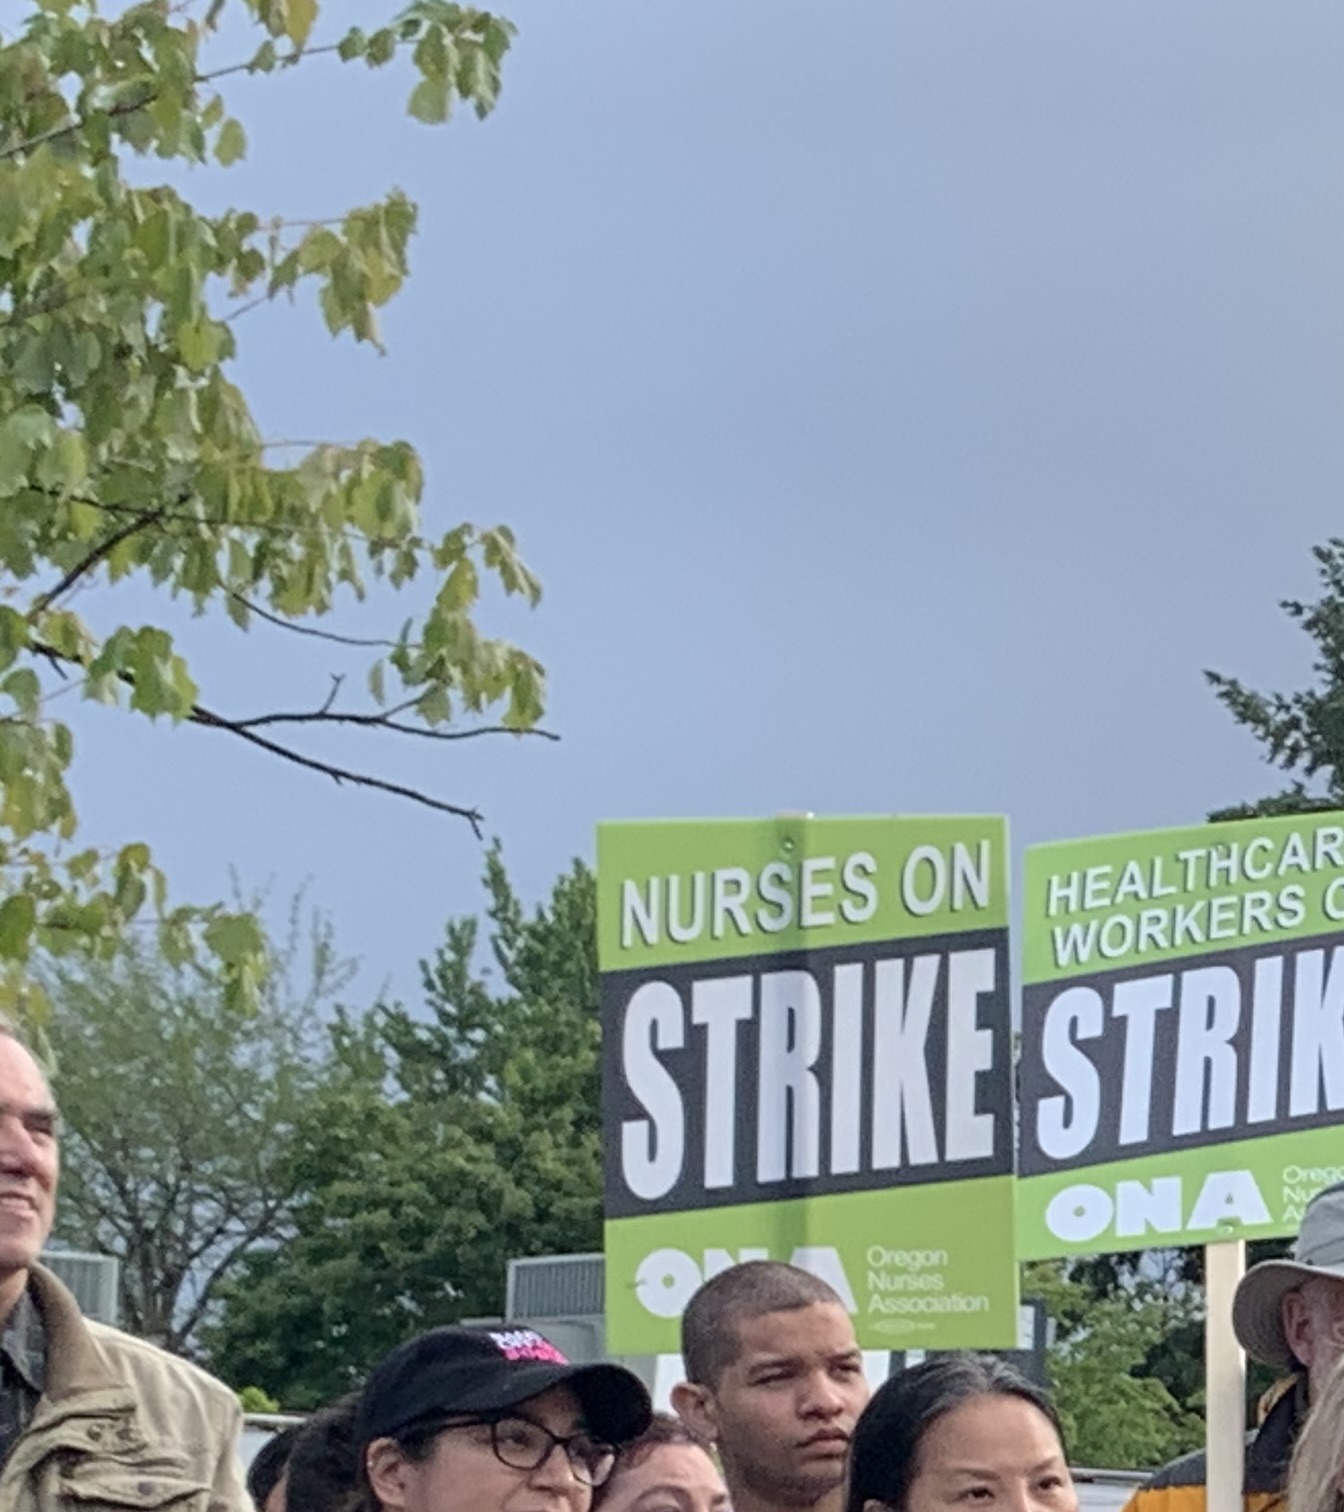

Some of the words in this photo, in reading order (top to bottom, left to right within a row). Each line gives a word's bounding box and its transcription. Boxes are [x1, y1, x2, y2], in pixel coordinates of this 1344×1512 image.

[621, 851, 878, 948] NURSES
[901, 839, 990, 917] ON
[1052, 884, 1306, 968] WORKERS
[620, 946, 997, 1200] STRIKE
[1046, 1169, 1273, 1243] ONA
[866, 1245, 949, 1270] Oregon
[866, 1270, 944, 1292] Nurses
[866, 1292, 990, 1314] Association
